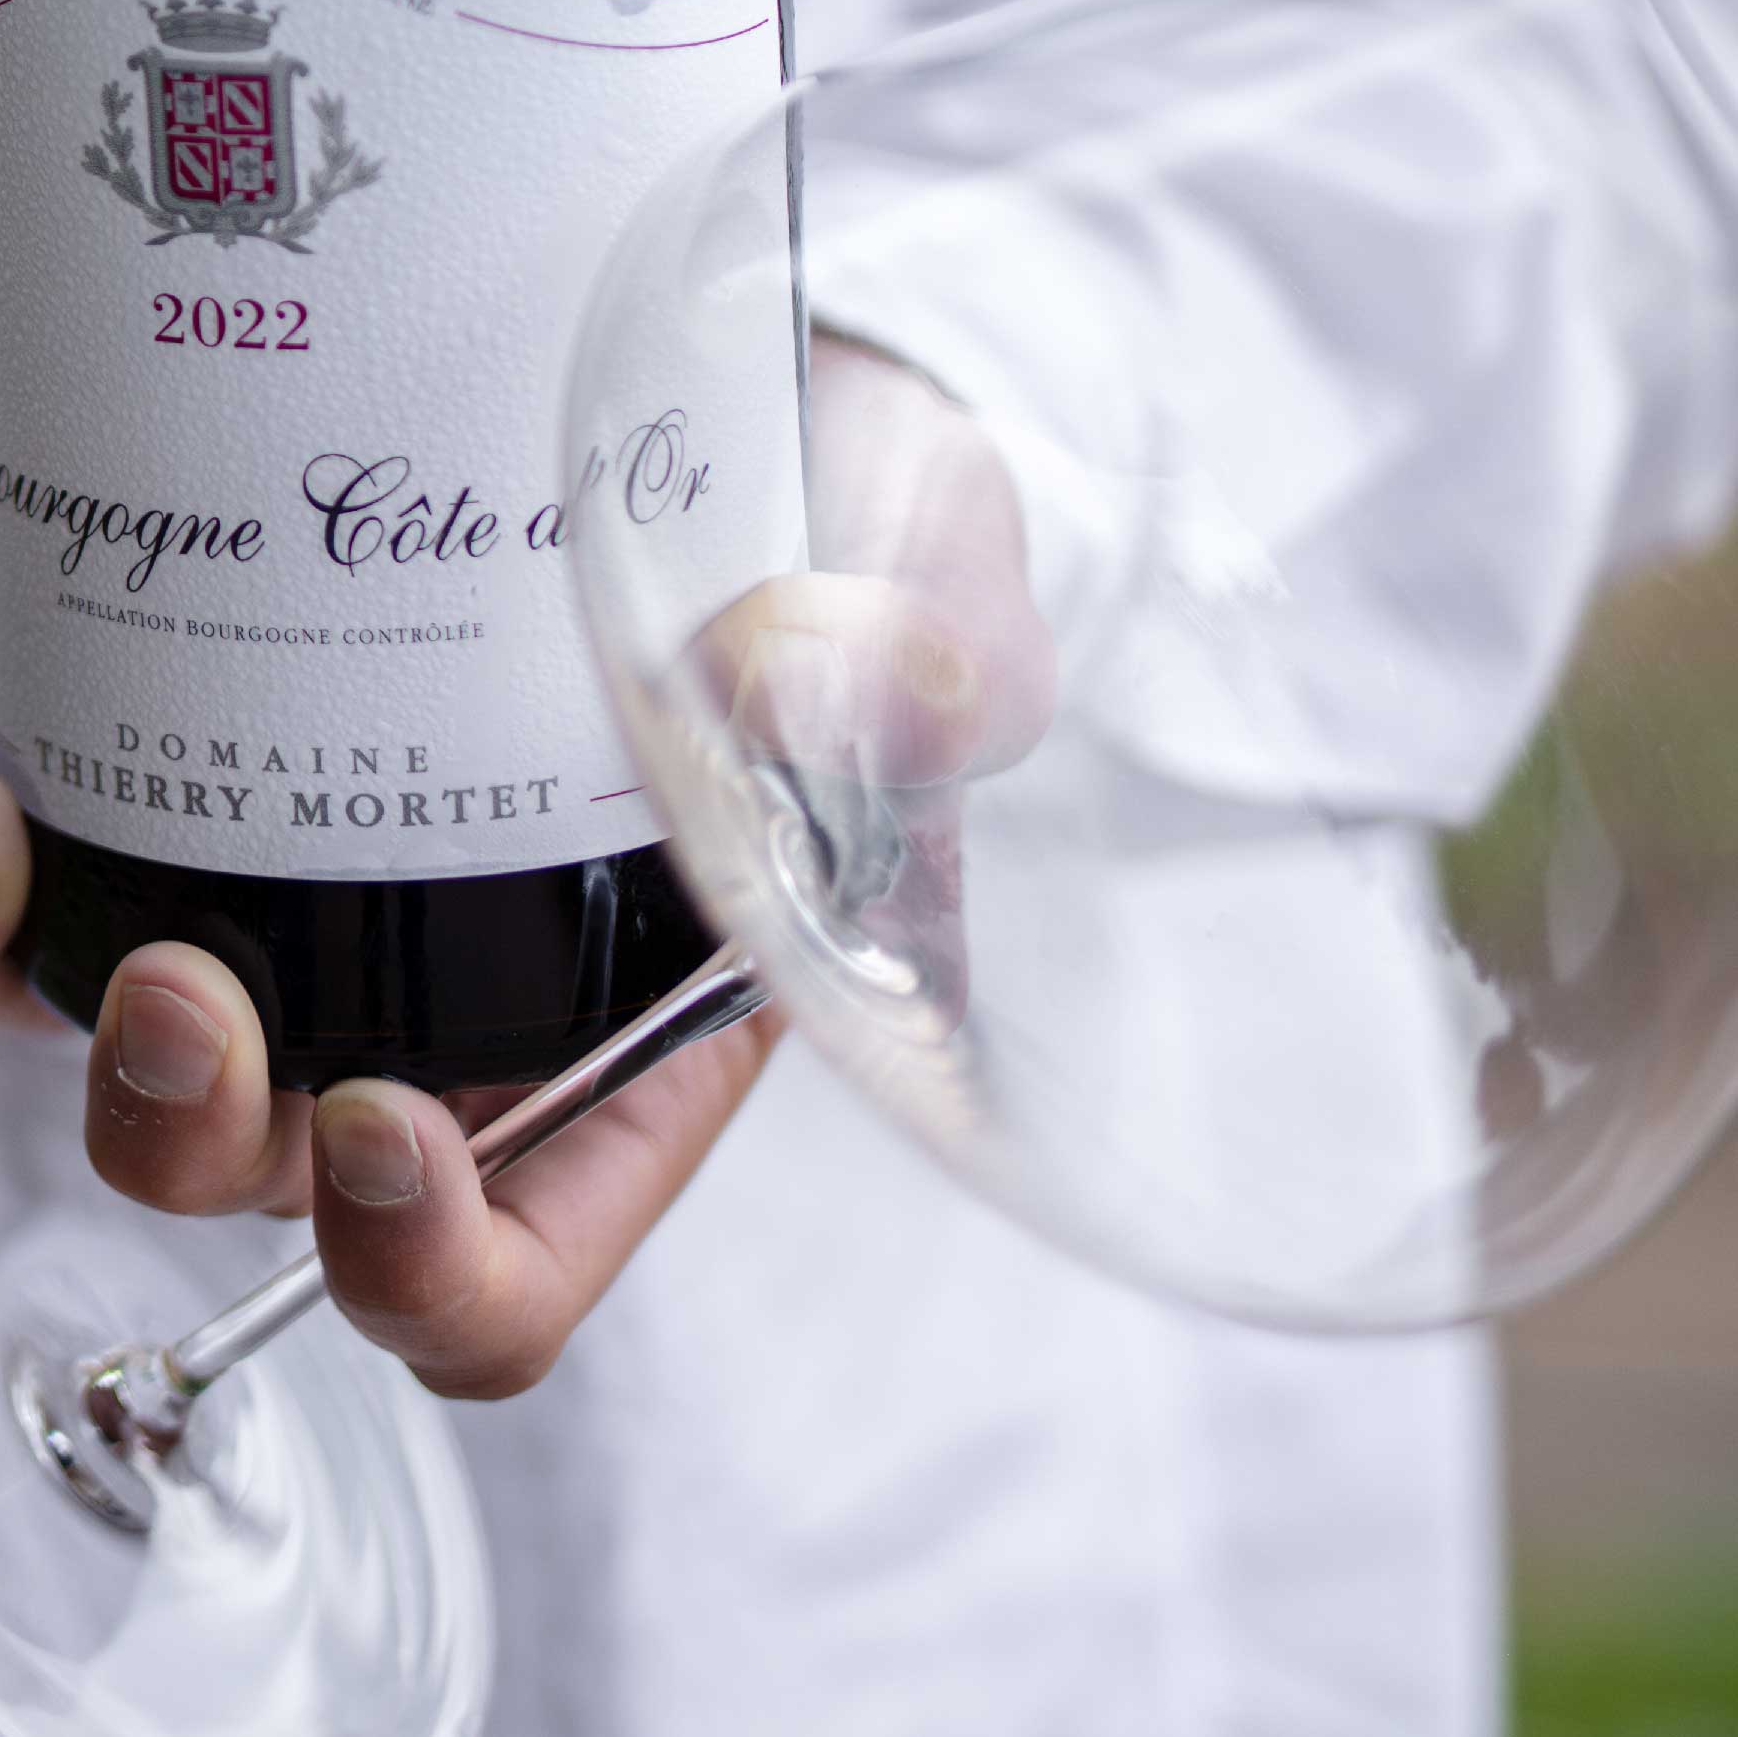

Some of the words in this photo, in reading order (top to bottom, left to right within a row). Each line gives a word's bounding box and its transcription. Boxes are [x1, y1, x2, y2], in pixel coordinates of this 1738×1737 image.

[153, 292, 310, 350] 2022
[302, 453, 501, 578] Côte
[57, 592, 176, 633] APPELLATION
[186, 619, 332, 645] BOURGOGNE
[342, 619, 486, 645] CONTRÔLÉE
[116, 722, 430, 775] DOMAINE
[34, 735, 253, 822] THIERRY
[290, 775, 559, 828] MORTET
